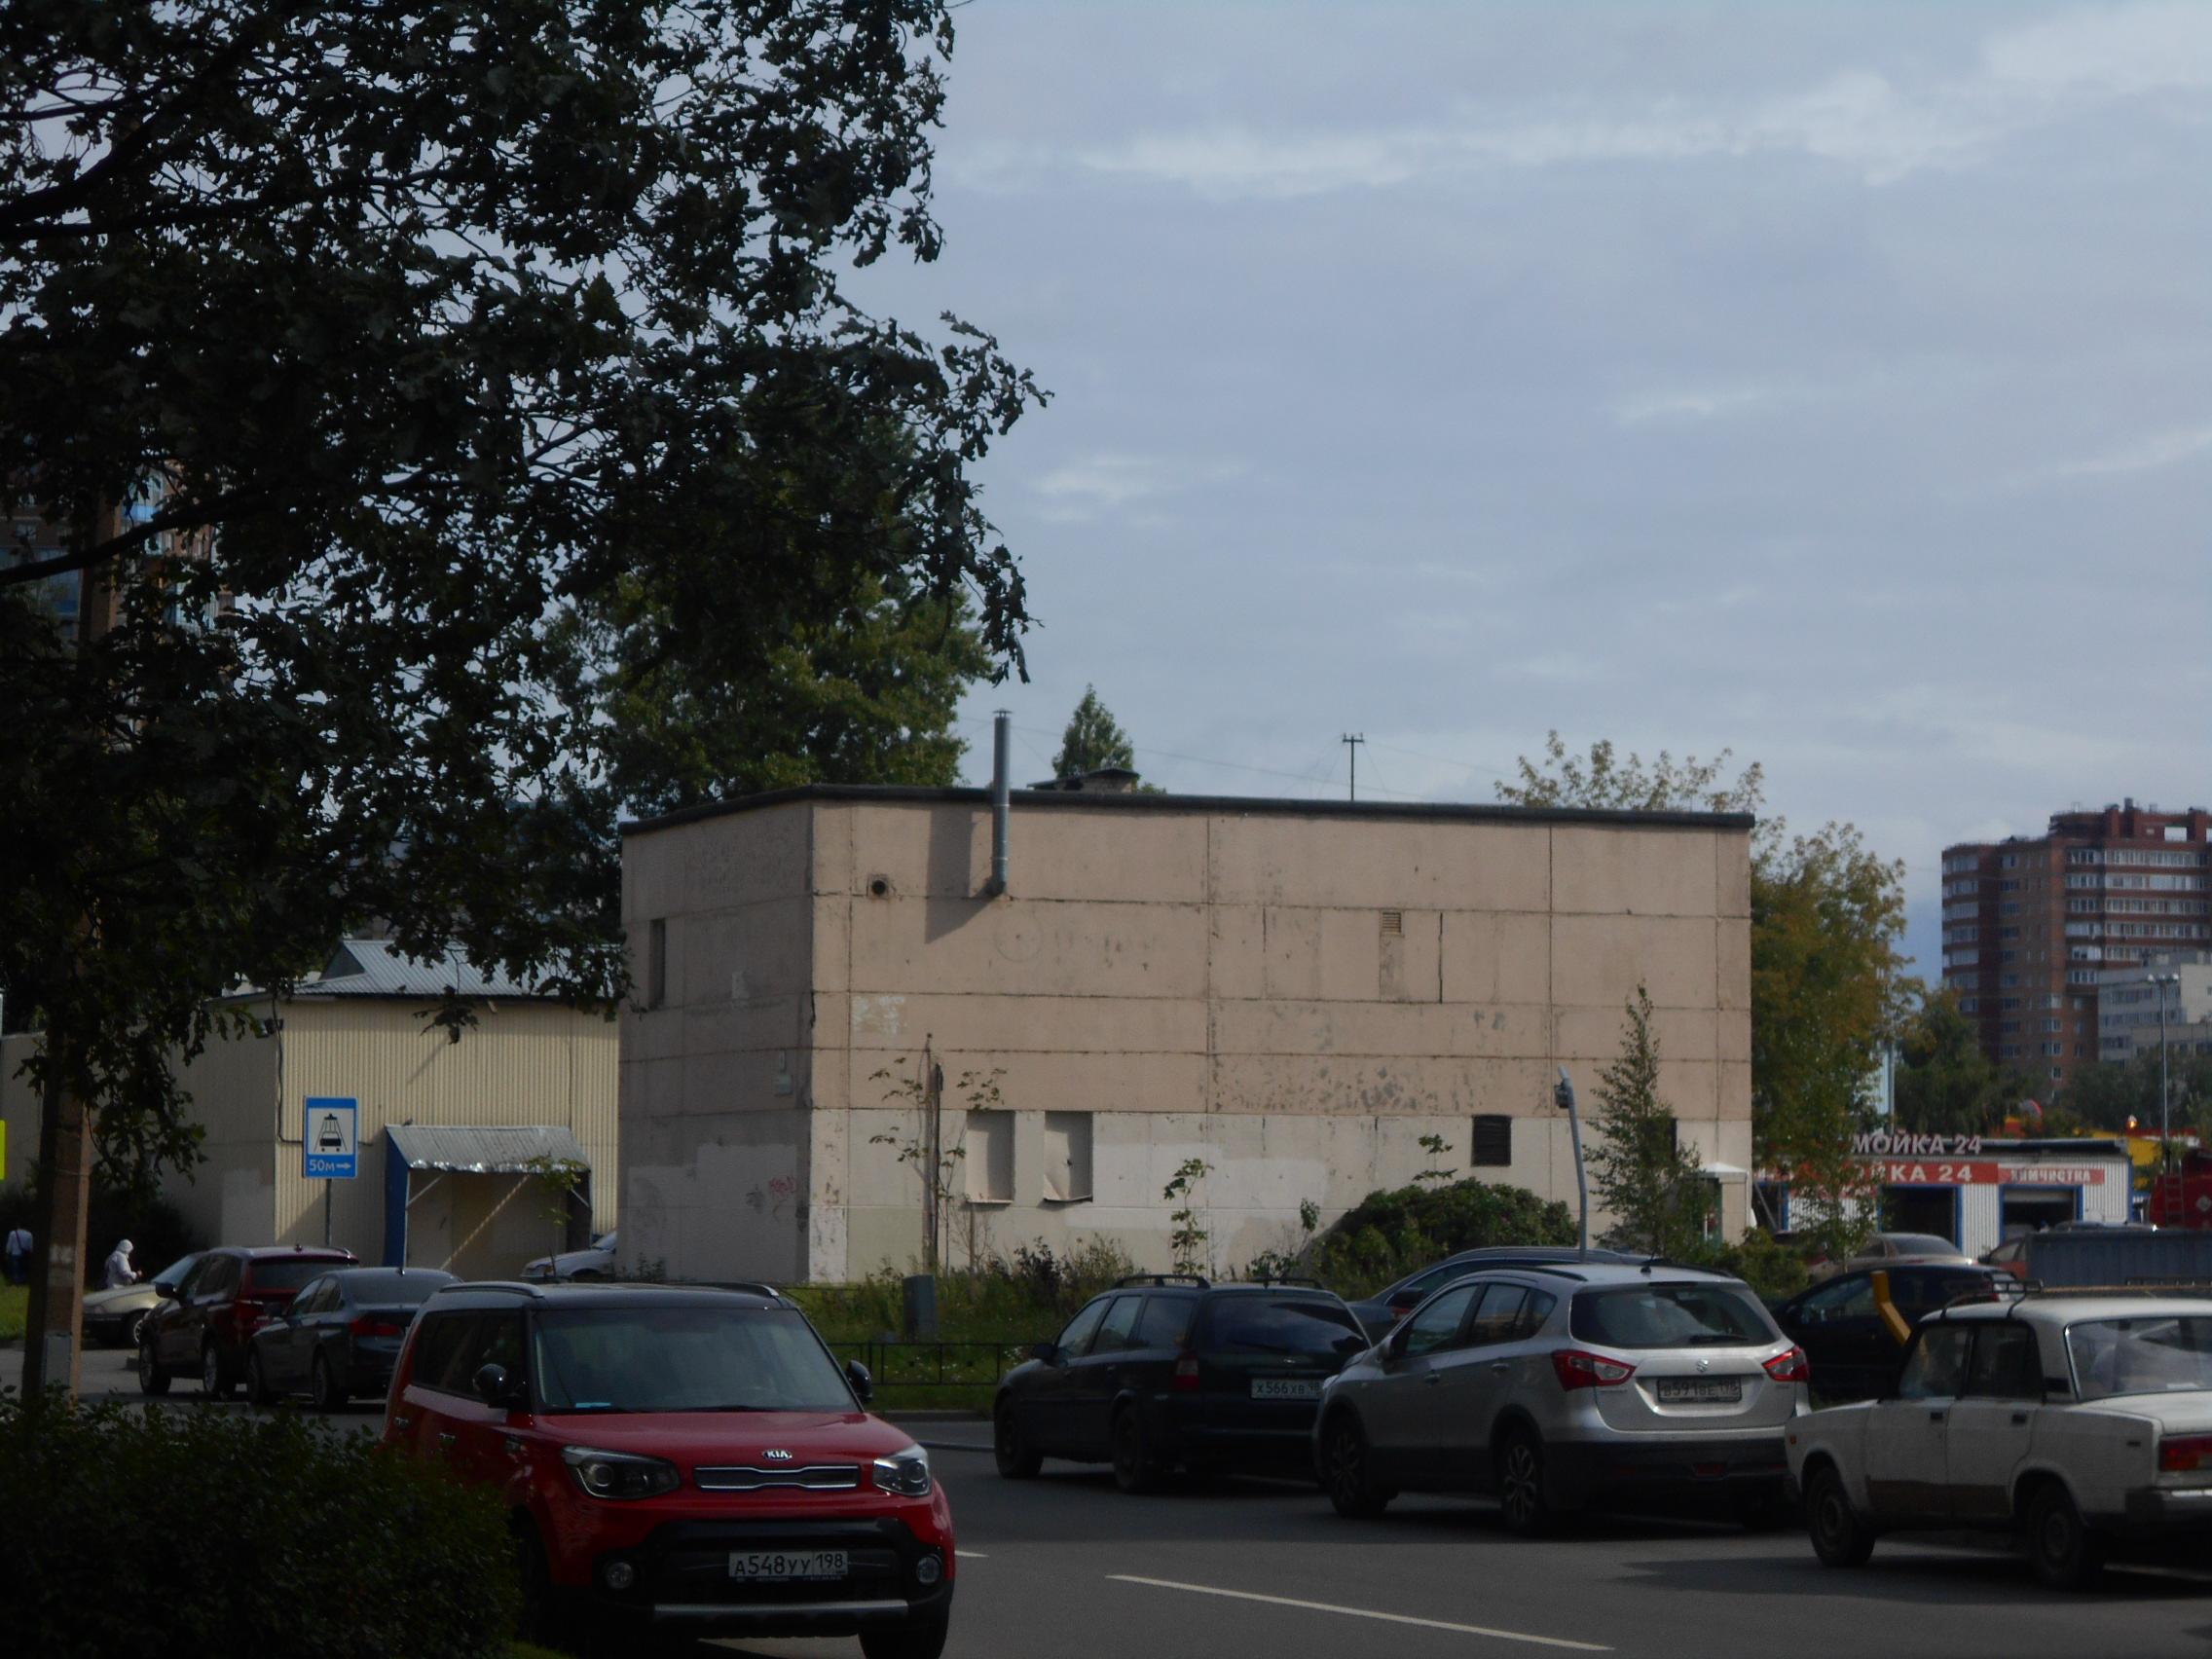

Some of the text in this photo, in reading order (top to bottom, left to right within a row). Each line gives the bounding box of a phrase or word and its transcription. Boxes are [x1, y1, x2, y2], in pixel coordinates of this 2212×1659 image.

[1954, 1133, 1982, 1156] 24
[1938, 1164, 1972, 1183] 24
[766, 1450, 790, 1458] KIA
[815, 1553, 843, 1568] 198
